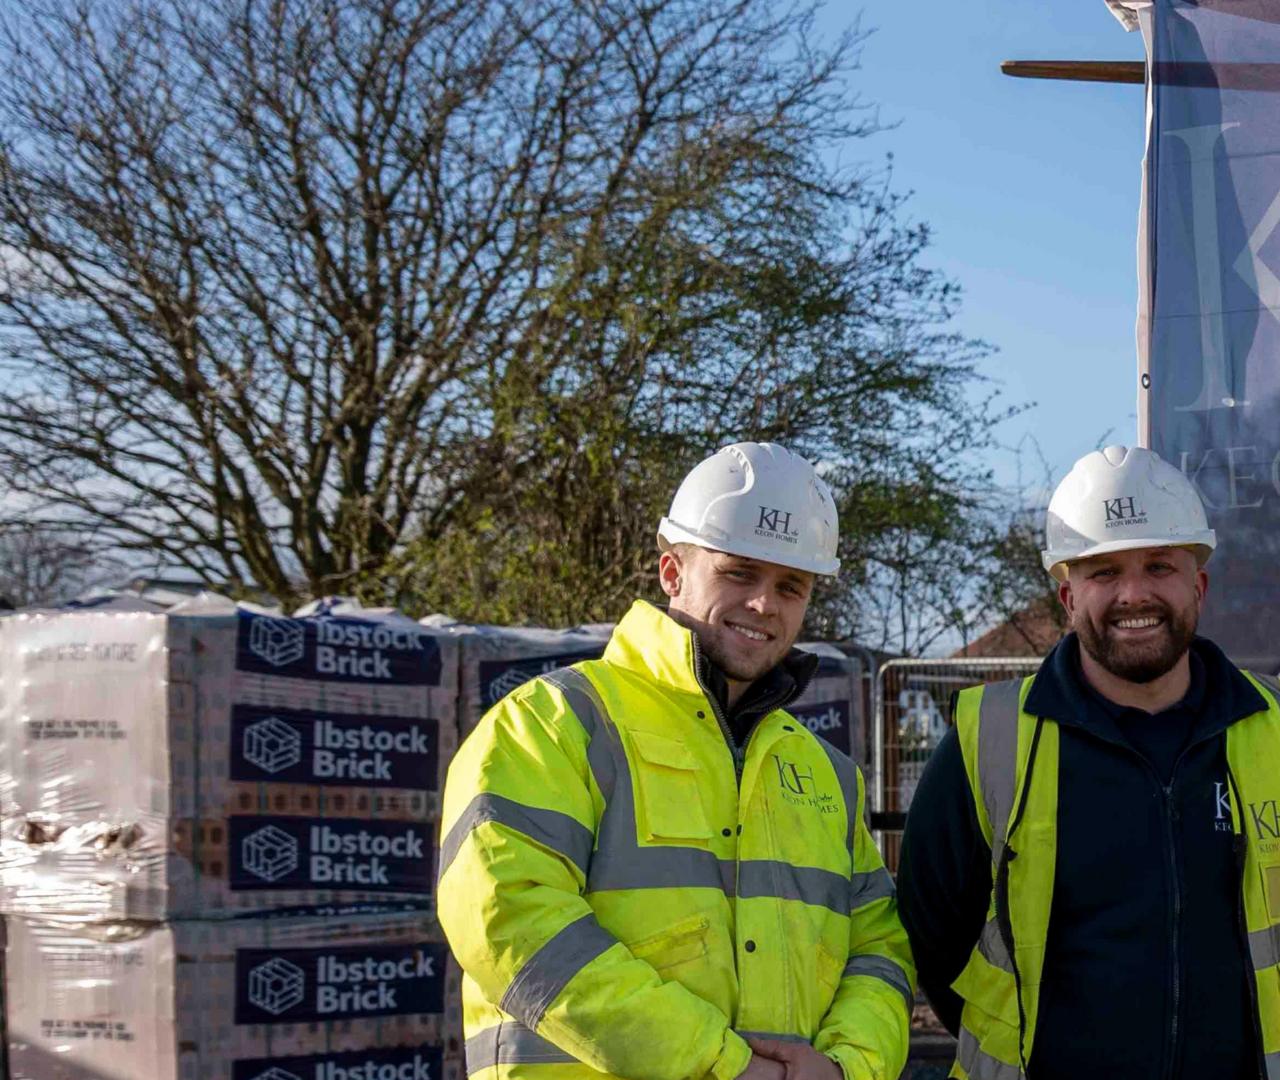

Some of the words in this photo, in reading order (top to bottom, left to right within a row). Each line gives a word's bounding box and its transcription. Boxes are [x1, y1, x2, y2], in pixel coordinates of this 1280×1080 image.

[757, 505, 792, 535] KH
[1103, 496, 1136, 521] KH
[1125, 517, 1148, 526] HOMES
[776, 534, 798, 544] HOMES
[316, 617, 425, 650] Ibstock
[316, 645, 392, 679] Brick
[313, 720, 428, 754] Ibstock
[313, 749, 393, 781] Brick
[771, 754, 818, 797] KH
[310, 824, 423, 859] Ibstock
[310, 854, 389, 885] Brick
[317, 951, 435, 984] Ibstock
[316, 980, 397, 1014] Brick
